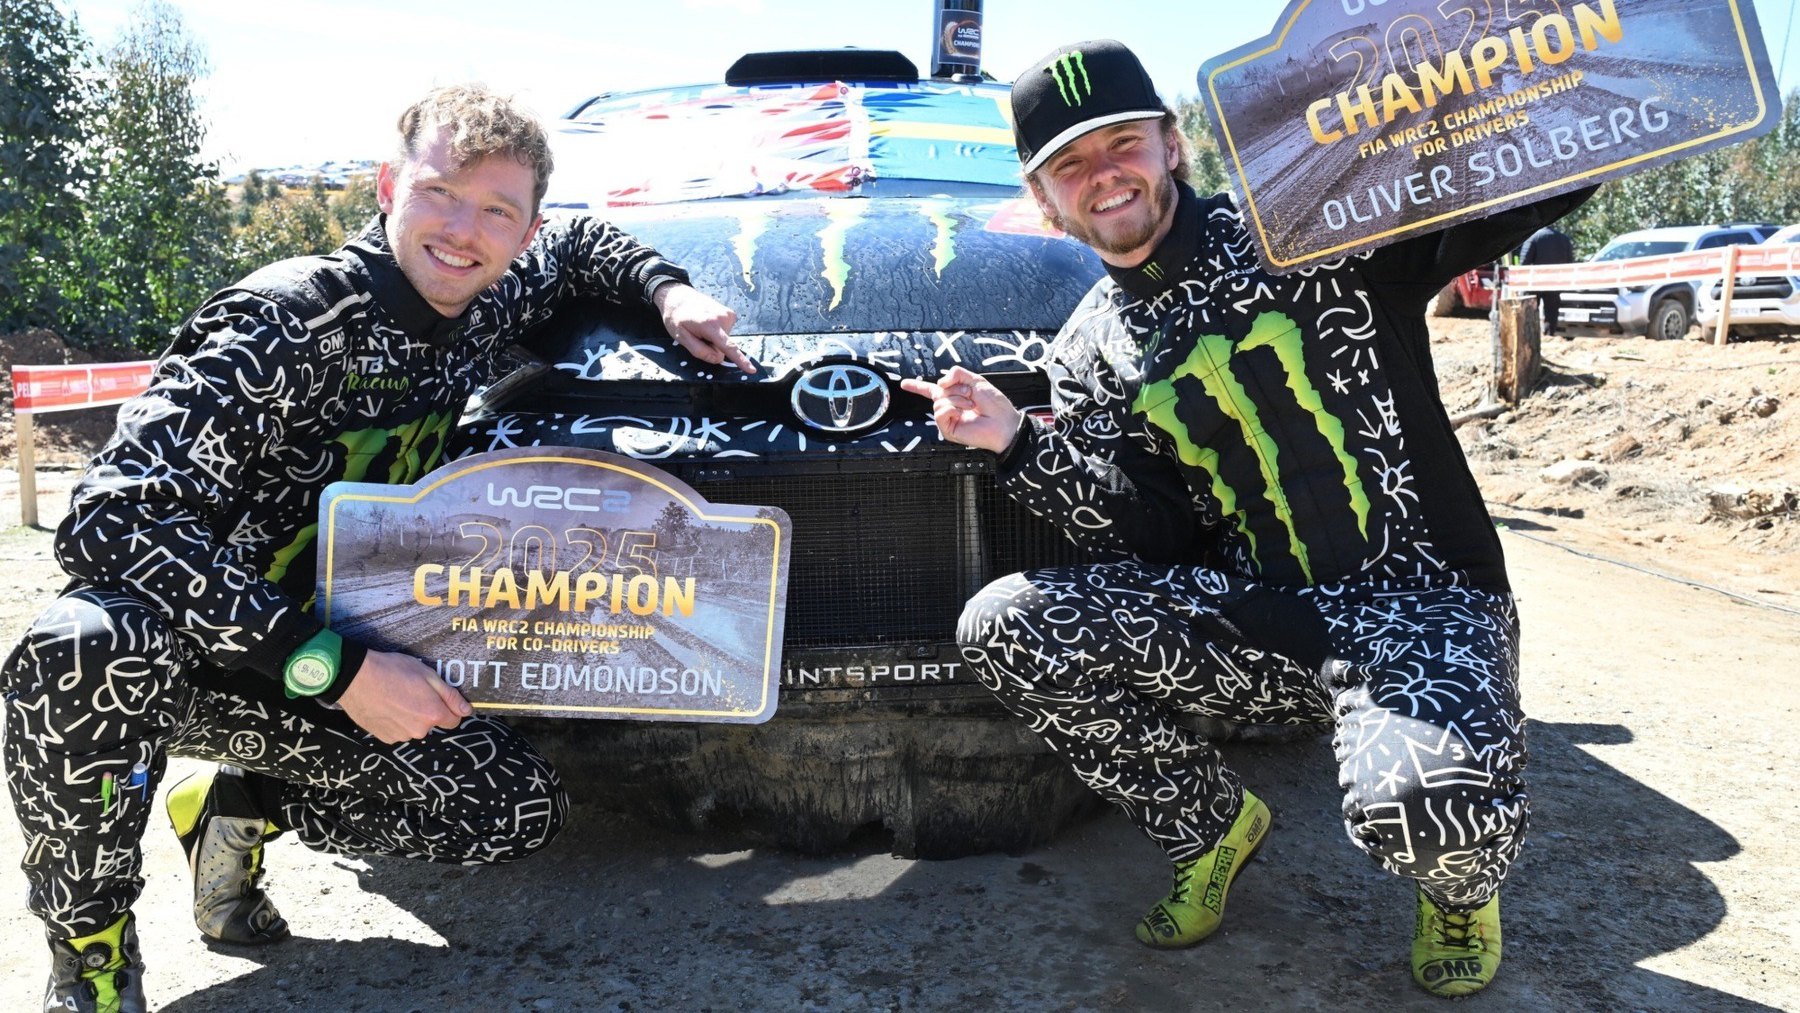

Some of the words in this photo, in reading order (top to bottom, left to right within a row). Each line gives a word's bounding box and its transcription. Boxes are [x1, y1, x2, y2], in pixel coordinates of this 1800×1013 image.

[1306, 0, 1623, 145] CHAMPION
[1359, 138, 1388, 159] FIA
[1389, 120, 1440, 148] WRC2
[1443, 69, 1584, 130] CHAMPIONSHIP
[1412, 137, 1448, 160] FOR
[1451, 109, 1530, 148] DRIVERS
[1322, 164, 1458, 231] OLIVER
[1468, 96, 1669, 187] SOLBERG
[487, 482, 632, 513] WRC2
[459, 521, 657, 600] 2025
[412, 563, 697, 618] CHAMPION
[452, 617, 478, 632] FIA
[483, 618, 528, 634] WRC2
[534, 621, 656, 640] CHAMPIONSHIP
[486, 636, 518, 651] FOR
[522, 637, 620, 655] CO-DRIVERS
[434, 658, 509, 690] IOTT
[521, 662, 722, 697] EDMONDSON
[780, 662, 962, 685] INTSPORT
[1422, 960, 1483, 983] OMP
